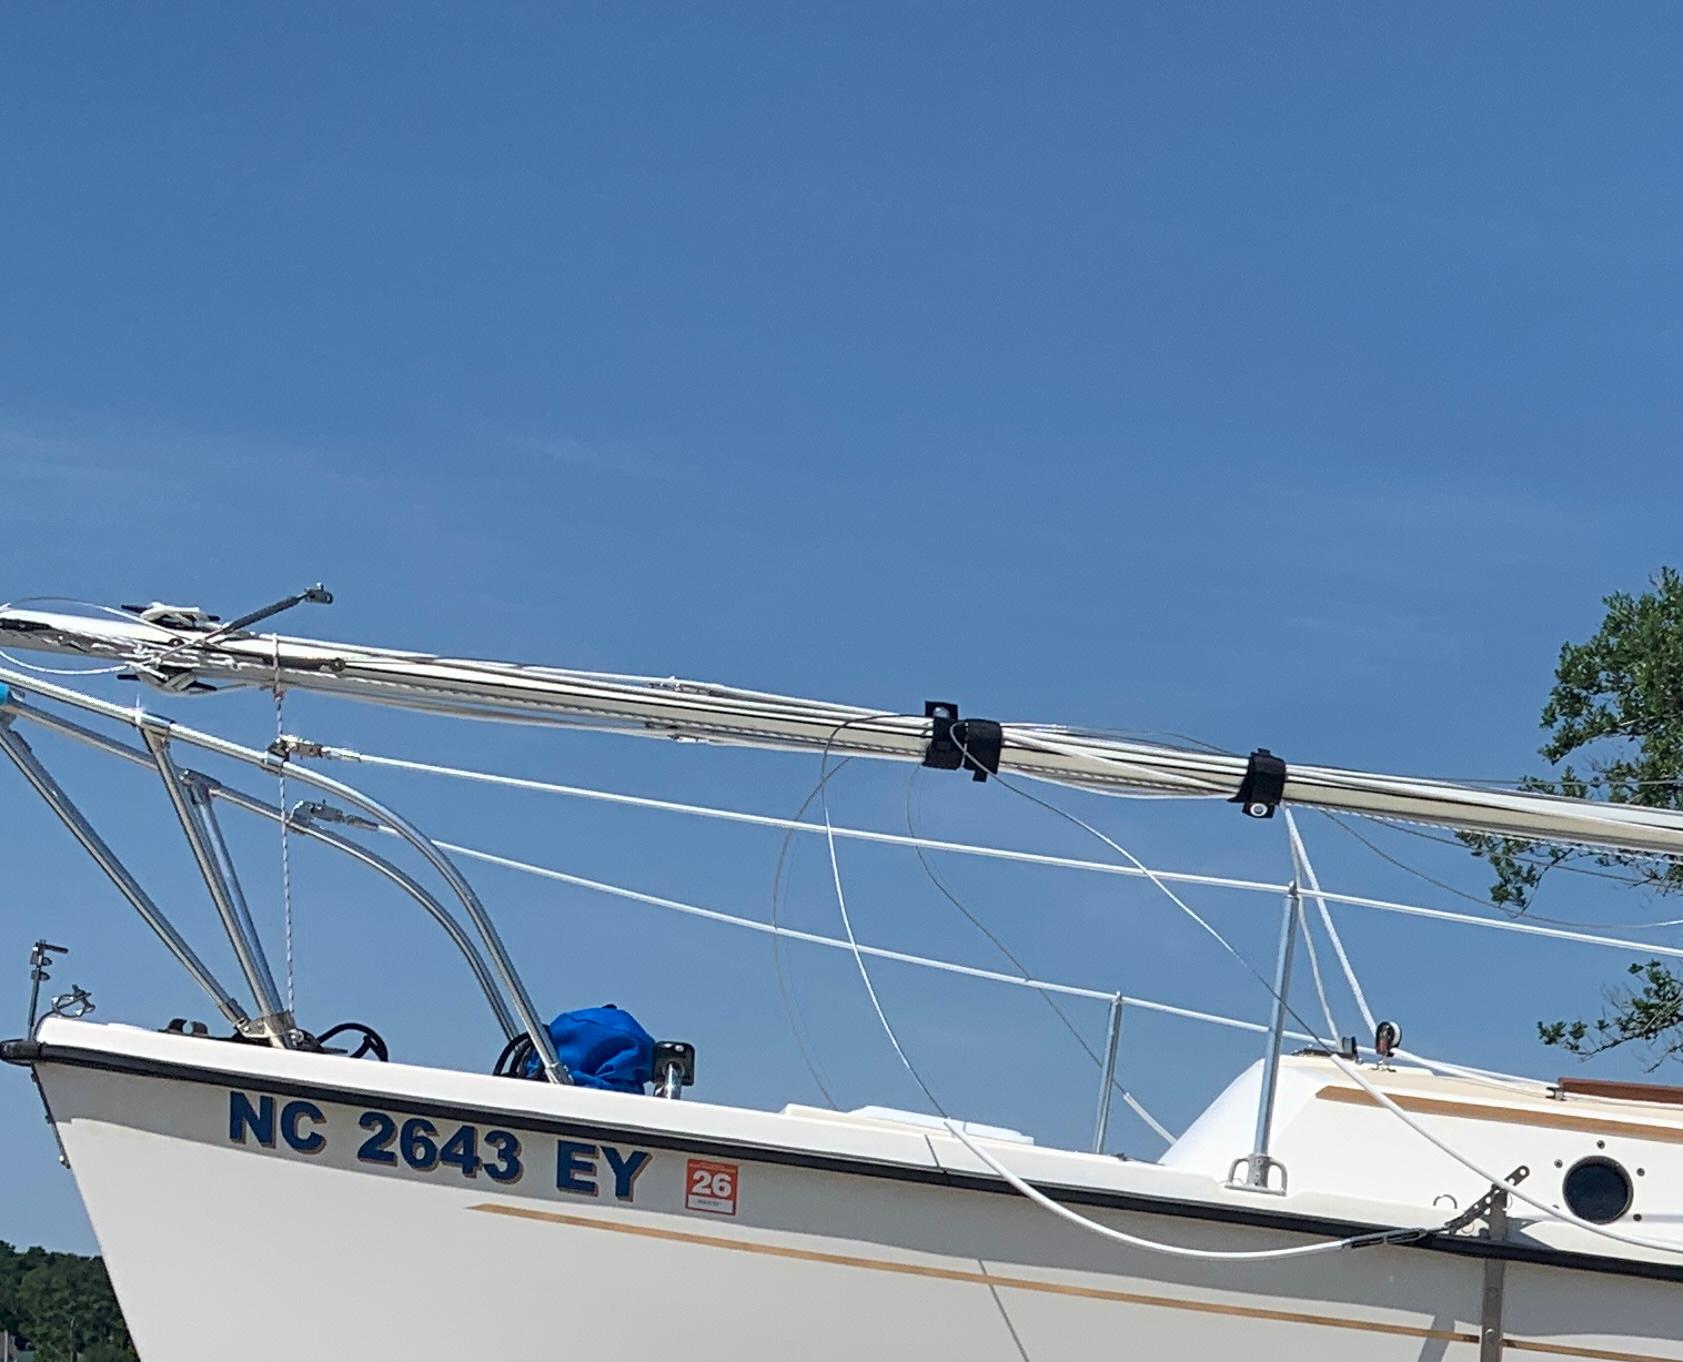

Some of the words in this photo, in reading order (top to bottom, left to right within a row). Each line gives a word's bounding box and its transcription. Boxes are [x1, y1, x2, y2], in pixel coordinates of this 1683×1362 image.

[229, 1091, 327, 1155] NC
[356, 1111, 525, 1185] 2643
[555, 1139, 654, 1202] EY
[691, 1169, 732, 1198] 26
